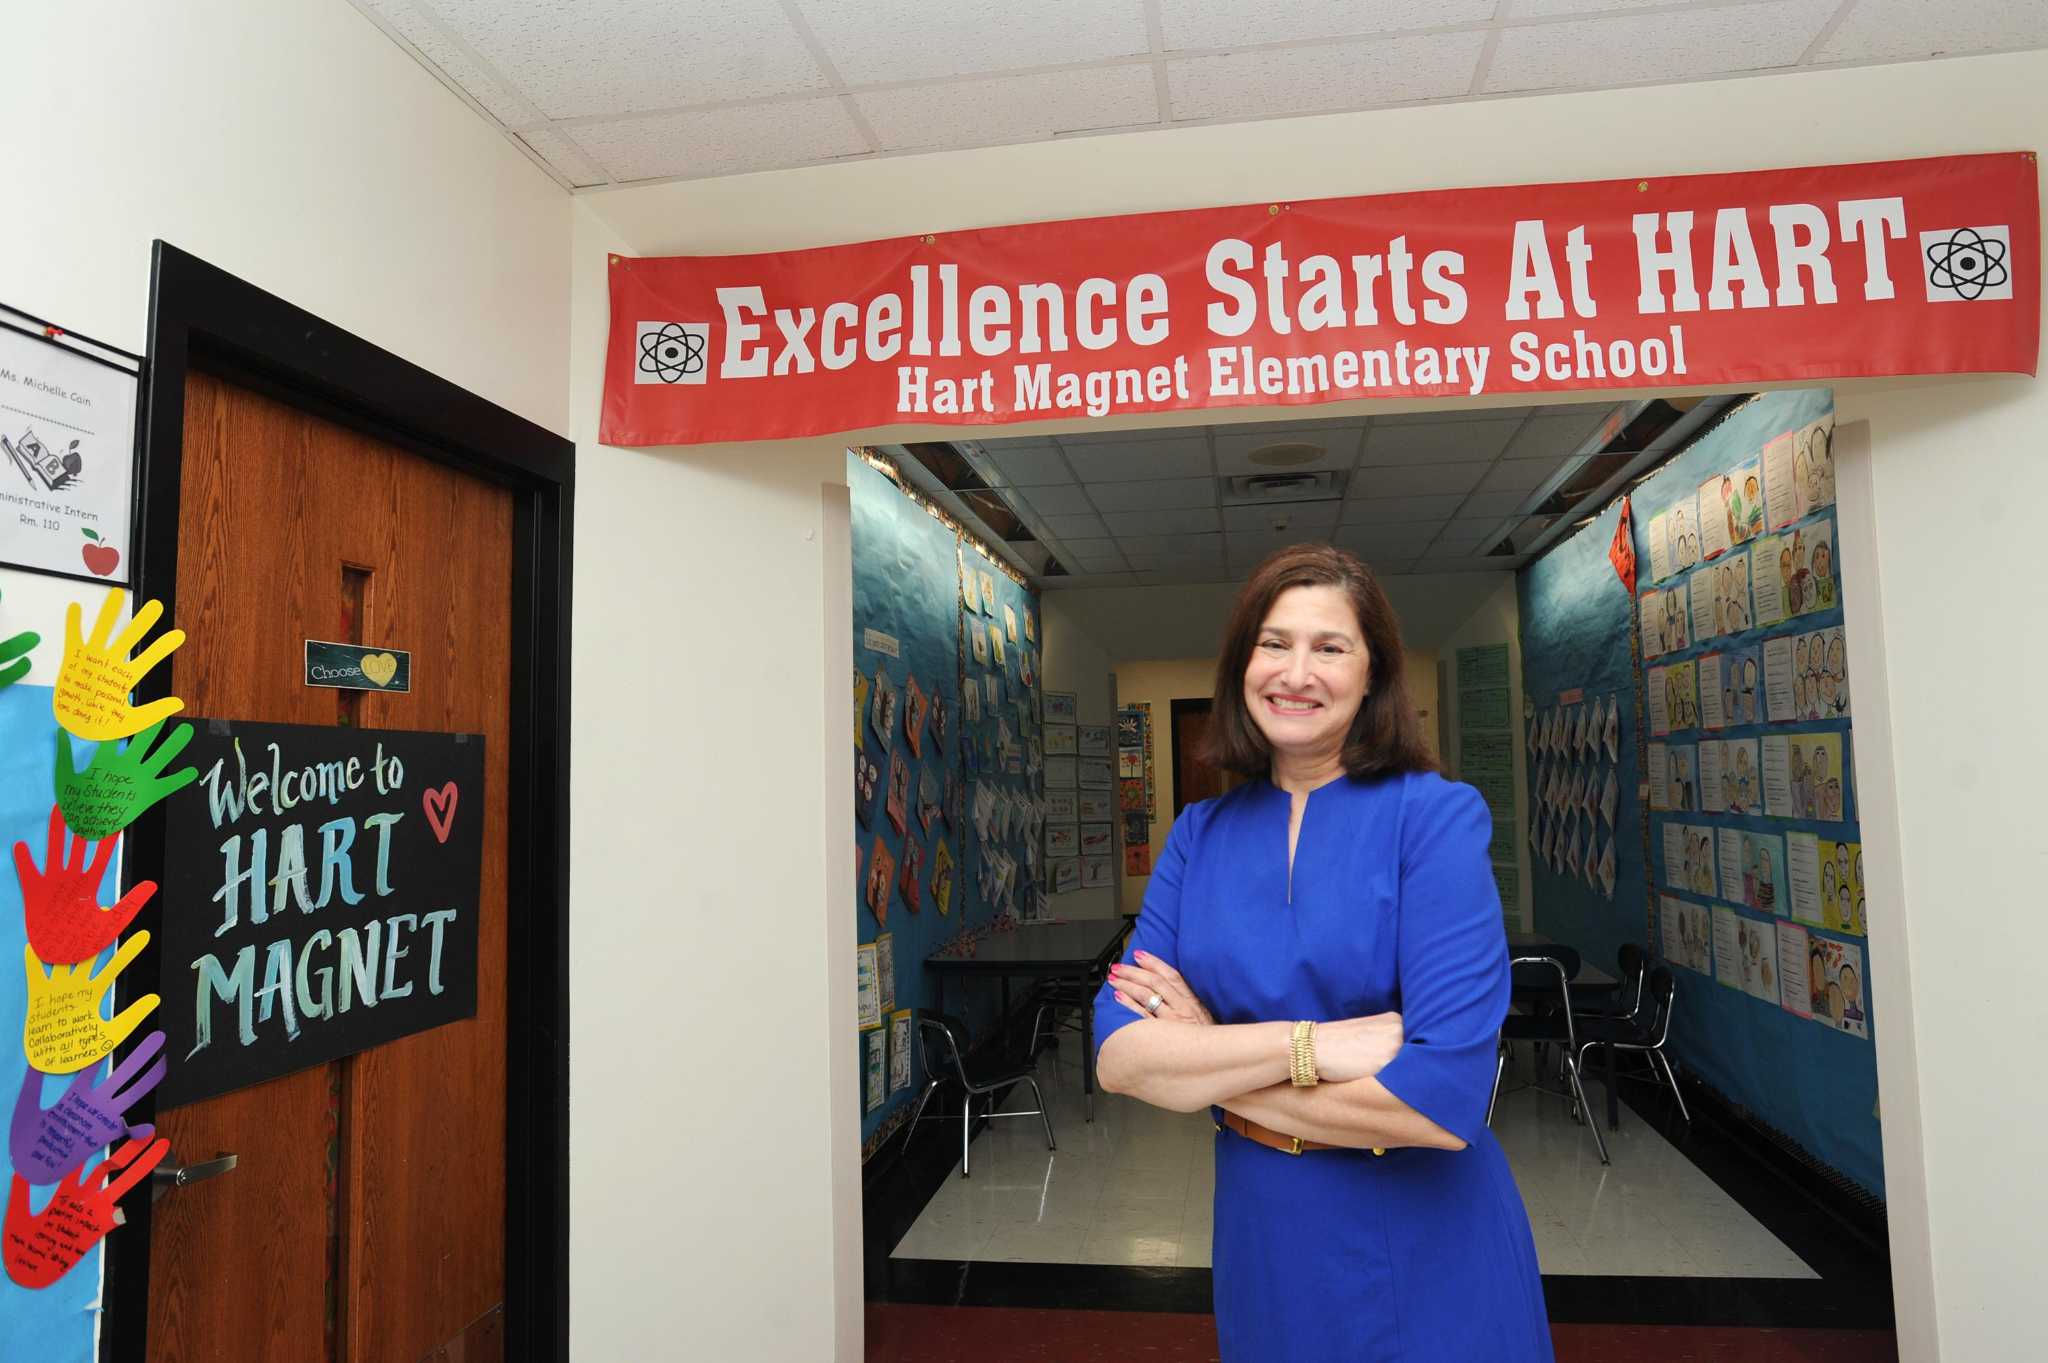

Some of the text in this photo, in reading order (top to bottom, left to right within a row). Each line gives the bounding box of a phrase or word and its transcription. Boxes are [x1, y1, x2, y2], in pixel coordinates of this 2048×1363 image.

[715, 197, 1907, 379] Excellence Starts At HART
[896, 324, 1688, 418] Hart Magnet Elementary School
[23, 376, 68, 399] Michelle
[64, 505, 99, 521] Intern
[43, 519, 61, 531] 110
[311, 664, 361, 680] Choose
[199, 737, 404, 829] Welcome to
[212, 812, 405, 937] HART
[185, 909, 457, 1062] MAGNET
[49, 992, 74, 1006] hope
[77, 989, 93, 1002] my
[28, 1010, 95, 1036] learn to work
[33, 1045, 56, 1058] with
[60, 1039, 74, 1054] all
[44, 1055, 56, 1067] of
